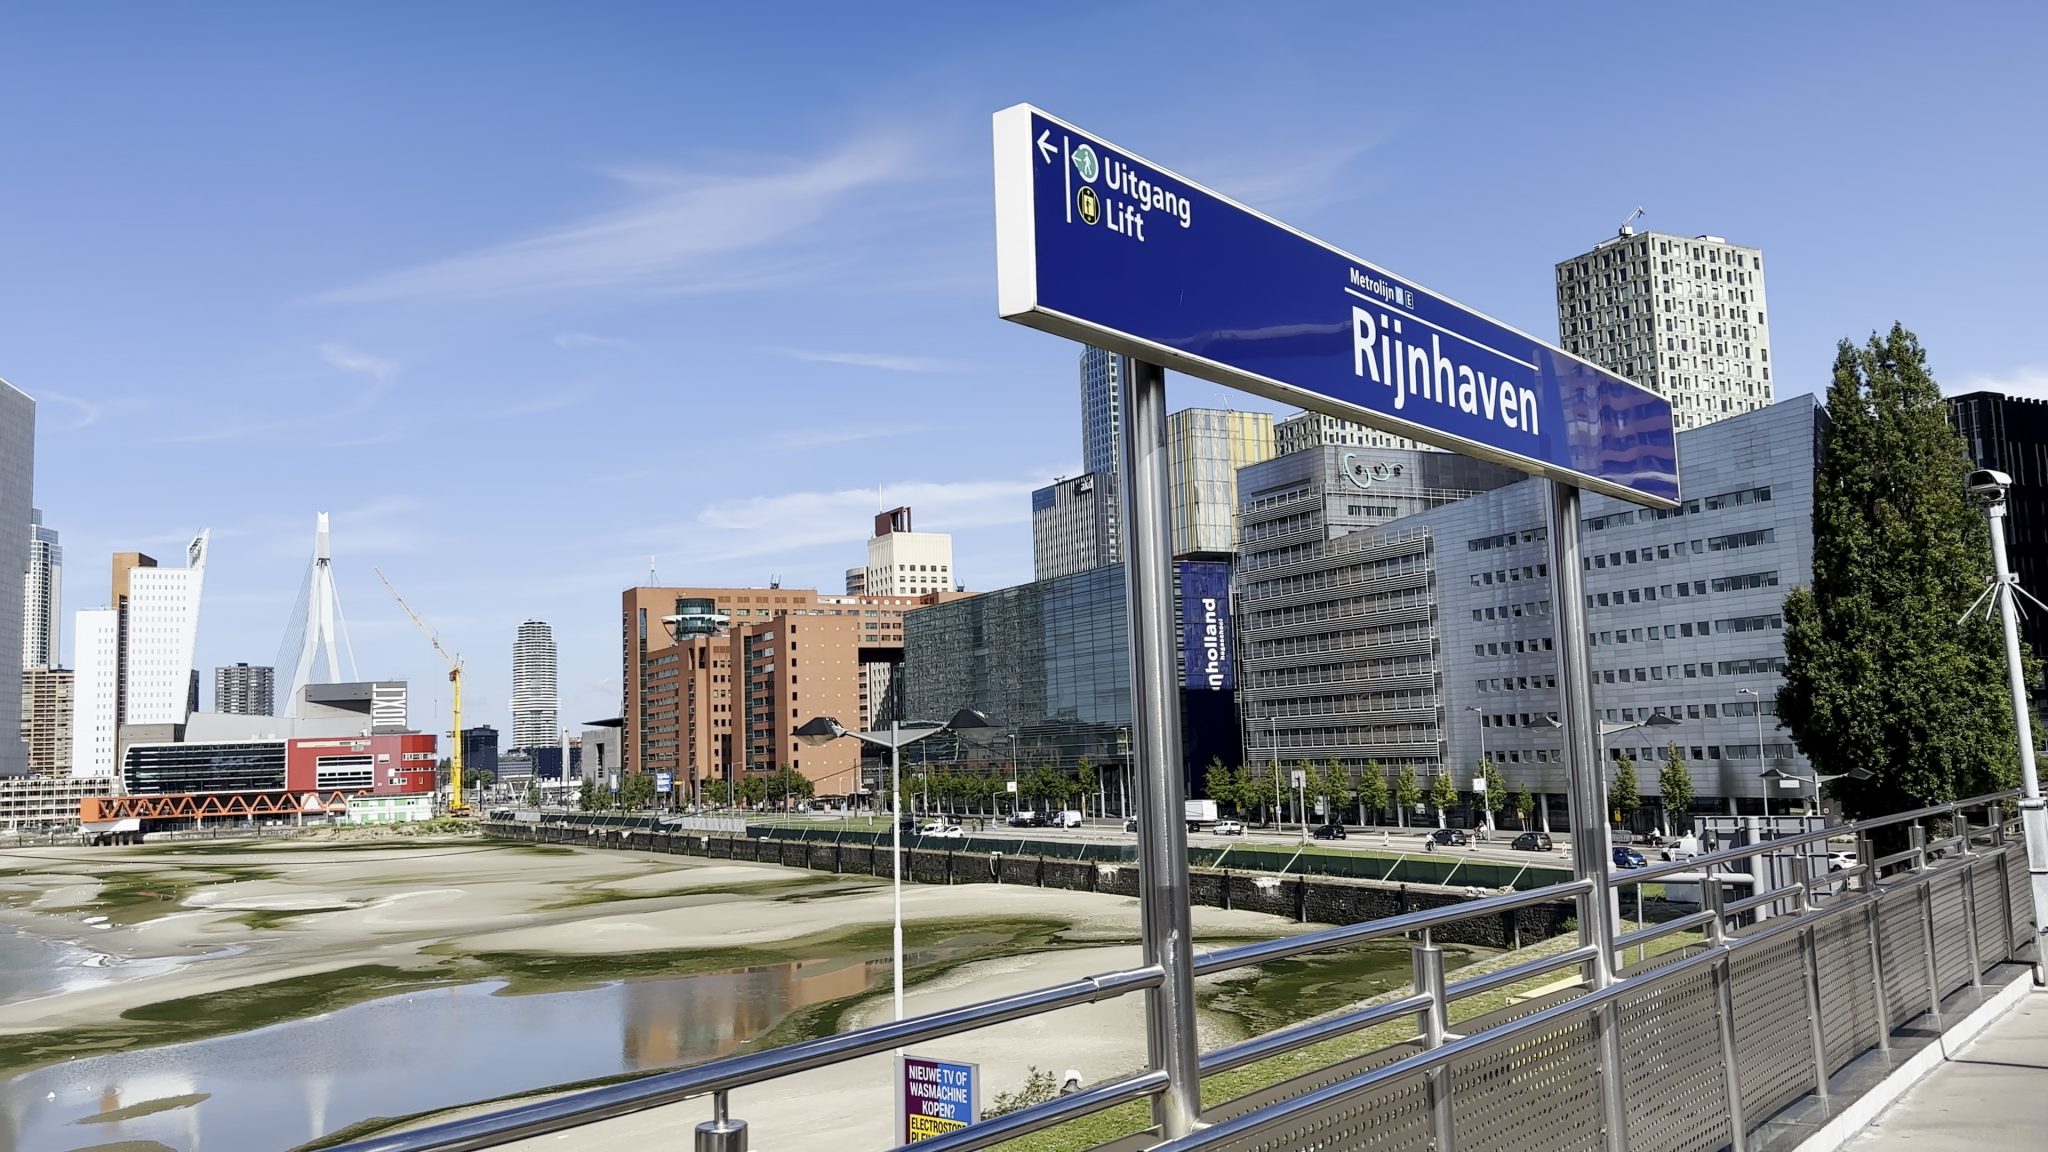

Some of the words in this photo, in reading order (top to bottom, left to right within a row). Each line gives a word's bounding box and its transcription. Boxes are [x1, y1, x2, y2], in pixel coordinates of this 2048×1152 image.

[1104, 157, 1191, 229] Uitgang
[1106, 198, 1144, 242] Lift
[1350, 267, 1394, 302] Metrolijn
[1352, 305, 1539, 436] Rijnhaven
[1202, 598, 1224, 691] inholland
[1218, 618, 1226, 661] hogeschool
[372, 683, 406, 726] LUXOR
[908, 1064, 942, 1083] NIEUWE
[943, 1069, 954, 1085] TV
[955, 1070, 968, 1087] OF
[910, 1081, 968, 1104] WASMACHINE
[922, 1099, 956, 1119] KOPEN?
